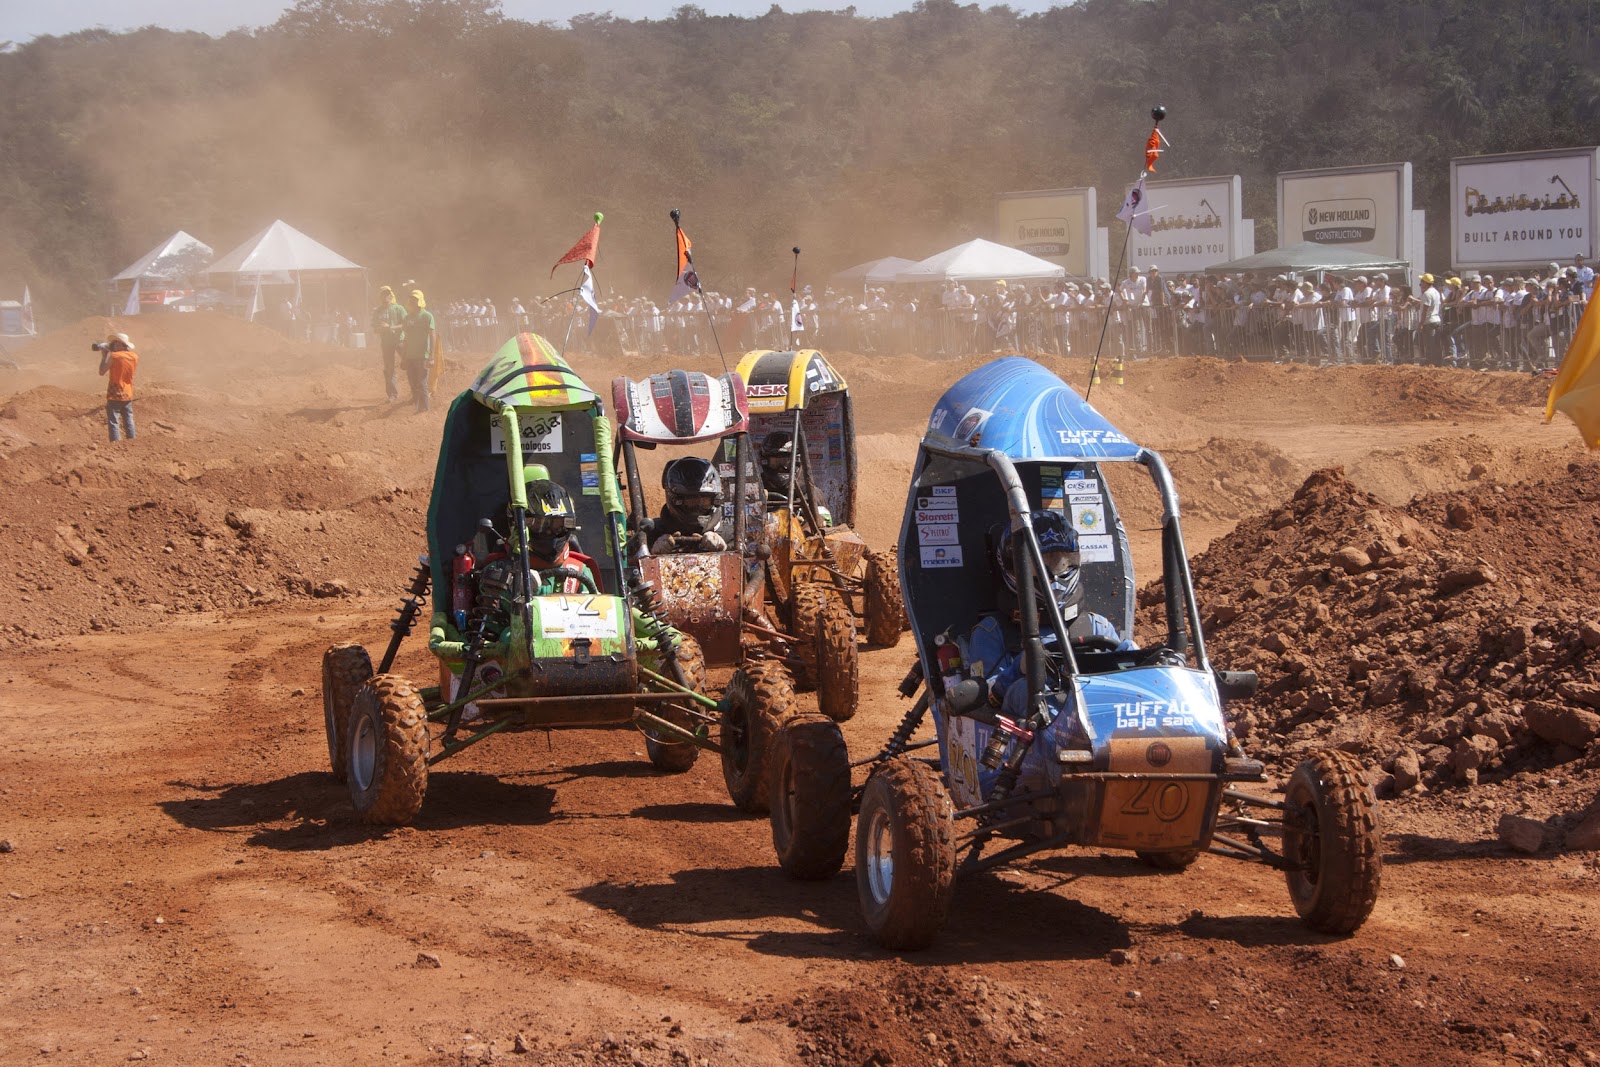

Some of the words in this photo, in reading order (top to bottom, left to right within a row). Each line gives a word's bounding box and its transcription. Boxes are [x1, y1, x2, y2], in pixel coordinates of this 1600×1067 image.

[1319, 210, 1336, 222] NEW
[1337, 209, 1370, 221] HOLLAND
[1026, 228, 1039, 238] NEW
[1314, 229, 1362, 240] CONSTRUCTION
[1464, 232, 1498, 243] BUILT
[1504, 229, 1553, 241] AROUND
[1559, 227, 1583, 239] YOU
[1137, 246, 1162, 257] BUILT
[1166, 244, 1203, 256] AROUND
[1206, 243, 1224, 254] YOU
[746, 384, 788, 396] NSK
[930, 408, 948, 429] 20
[918, 511, 954, 521] Starrett
[1116, 715, 1157, 731] baja
[1162, 716, 1194, 727] sae
[1120, 780, 1190, 823] 20
